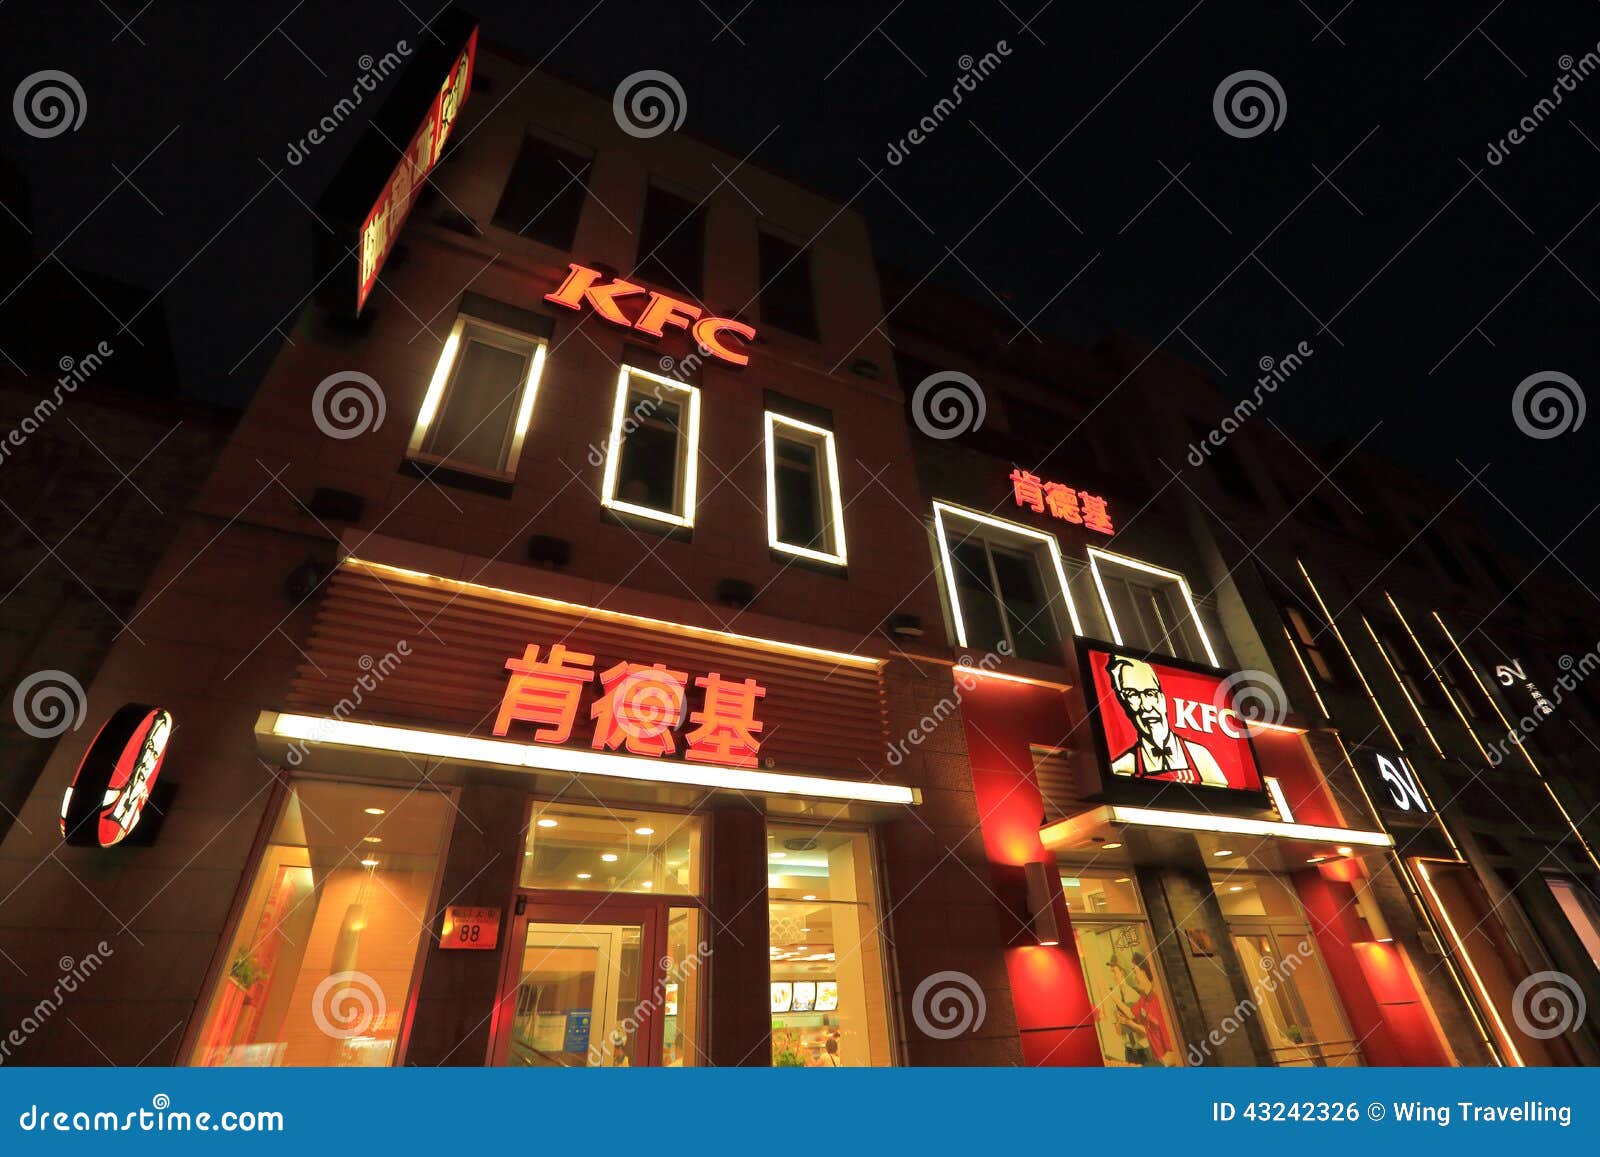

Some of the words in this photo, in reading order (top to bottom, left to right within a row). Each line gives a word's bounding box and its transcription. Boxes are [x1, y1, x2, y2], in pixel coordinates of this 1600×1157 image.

[544, 263, 756, 366] KFC
[1009, 469, 1115, 536] 肯德基
[492, 644, 767, 768] 肯德基
[1173, 697, 1242, 739] KFC
[459, 925, 481, 942] 88
